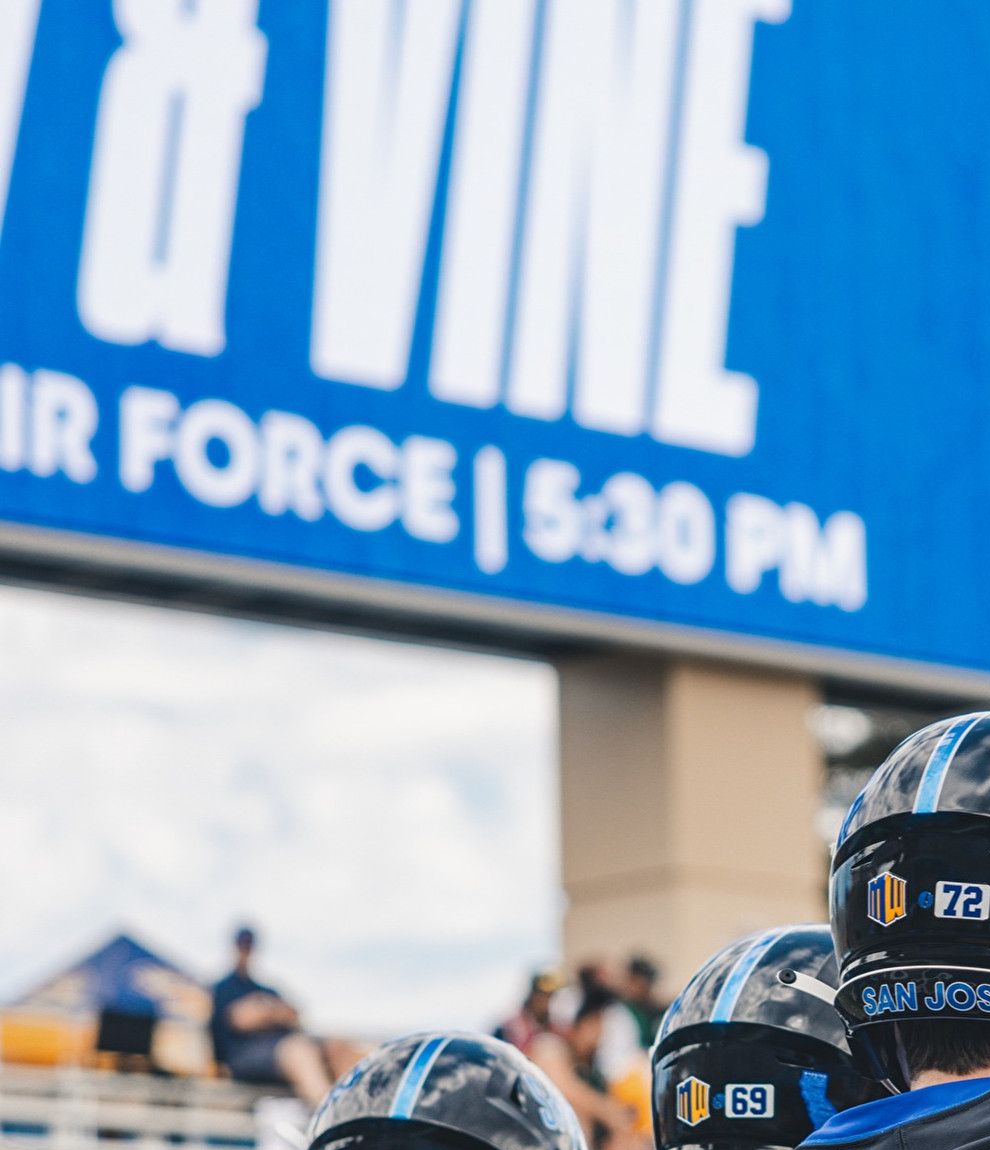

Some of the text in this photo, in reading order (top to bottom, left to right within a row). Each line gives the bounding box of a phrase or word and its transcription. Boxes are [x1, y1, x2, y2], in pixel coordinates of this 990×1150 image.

[77, 0, 268, 357] &
[311, 0, 793, 457] VINE
[119, 385, 460, 544] FORCE
[523, 458, 717, 585] 5:30
[726, 492, 867, 612] PM
[943, 884, 983, 918] 72
[862, 982, 919, 1015] SAN
[732, 1087, 767, 1115] 69
